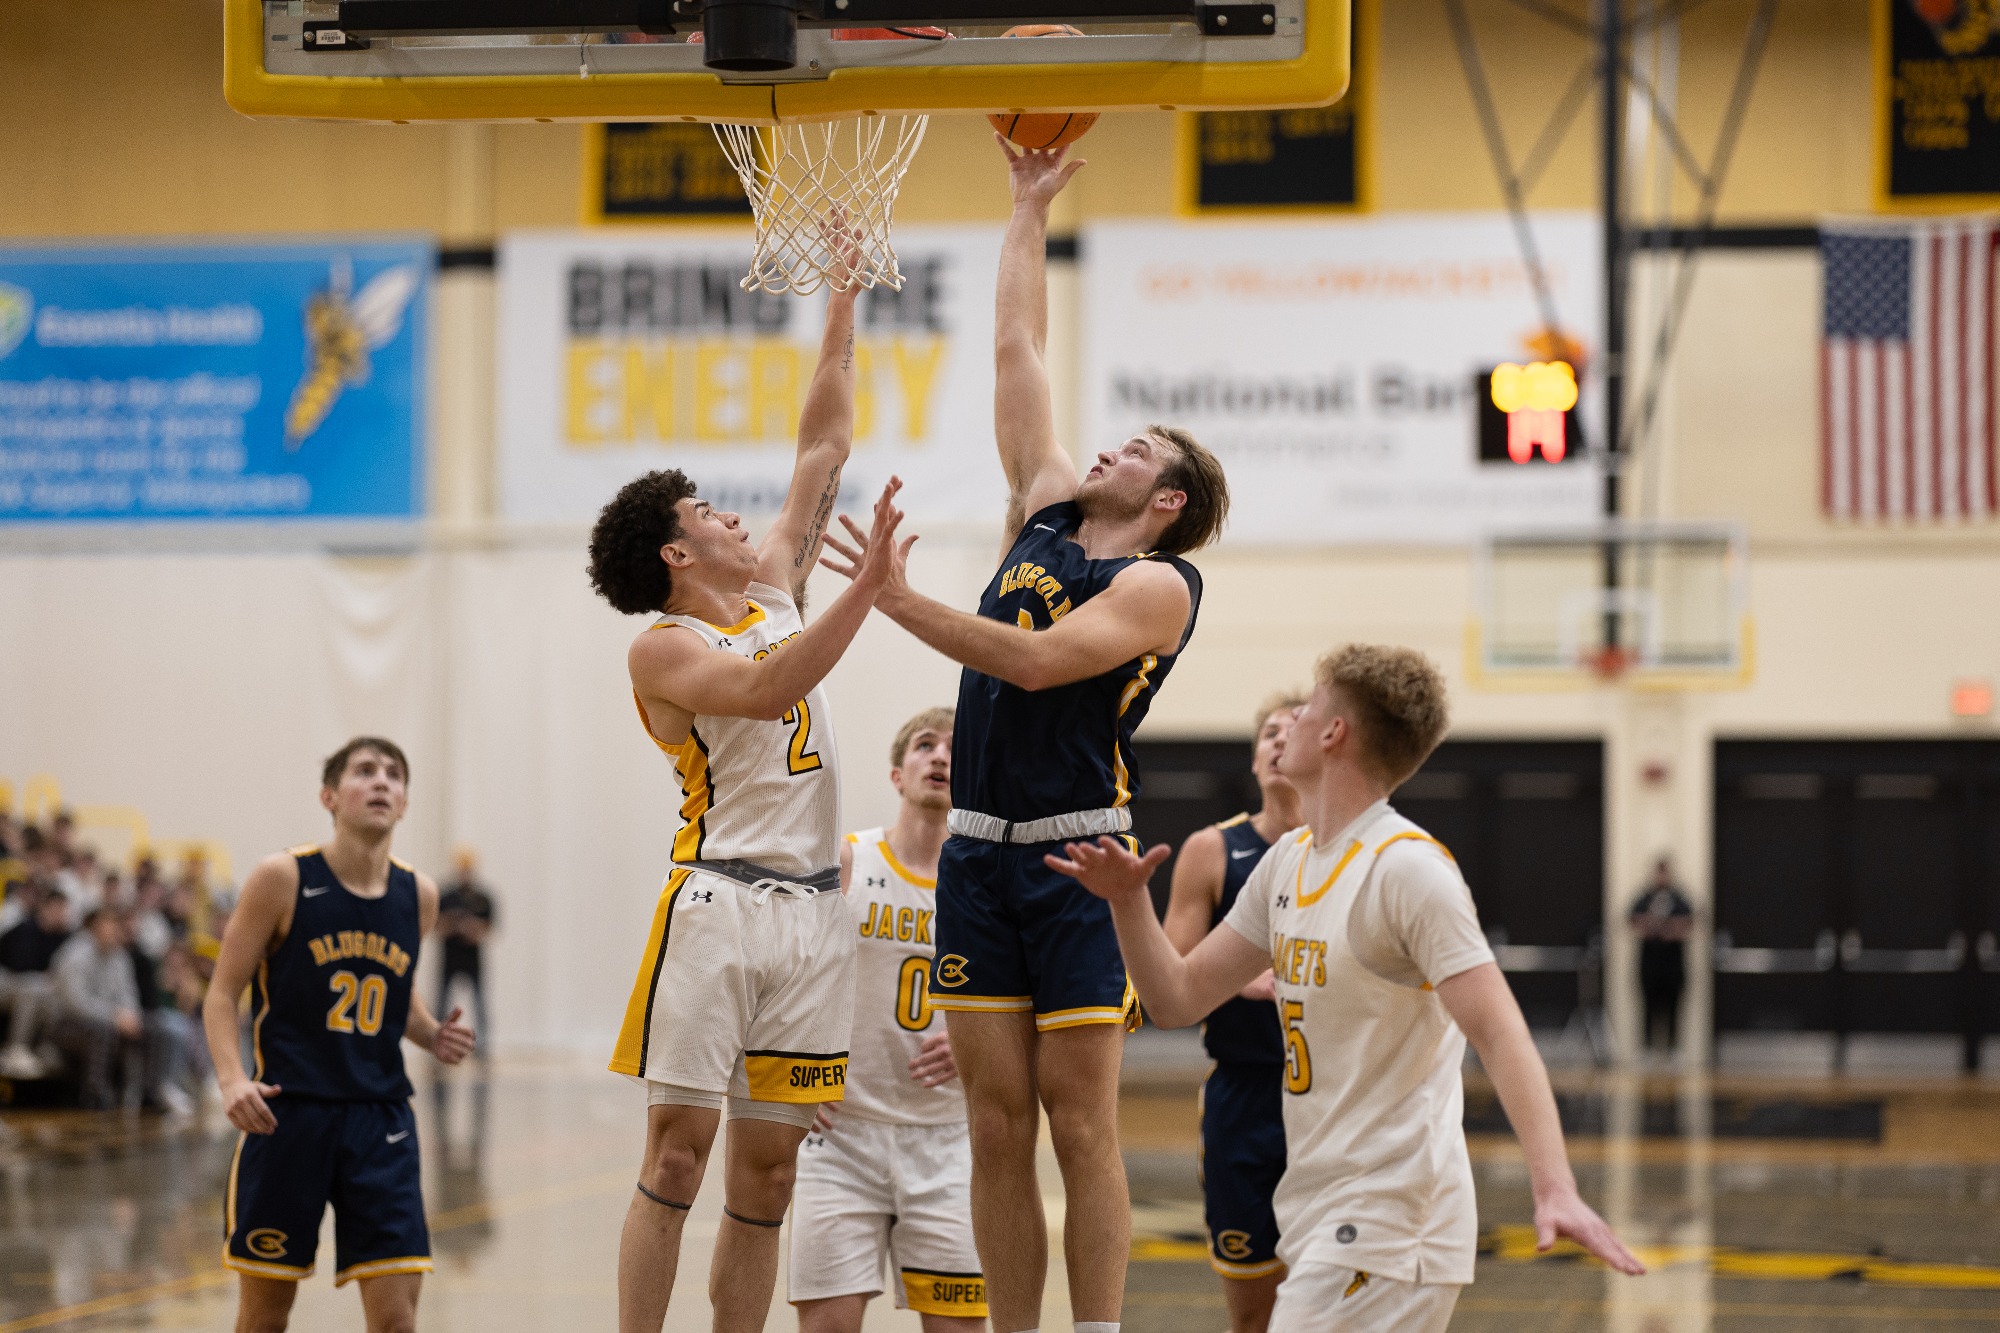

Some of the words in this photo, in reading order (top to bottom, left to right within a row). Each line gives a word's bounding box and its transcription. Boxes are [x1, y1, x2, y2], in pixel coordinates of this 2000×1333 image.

[566, 256, 792, 333] BRING
[1108, 368, 1358, 420] National
[782, 697, 823, 776] 2
[308, 930, 411, 977] BLUGOLDS
[860, 902, 934, 945] JACK
[326, 969, 388, 1036] 20
[896, 956, 933, 1032] 0
[790, 1064, 848, 1088] SUPER
[1281, 997, 1312, 1096] 5
